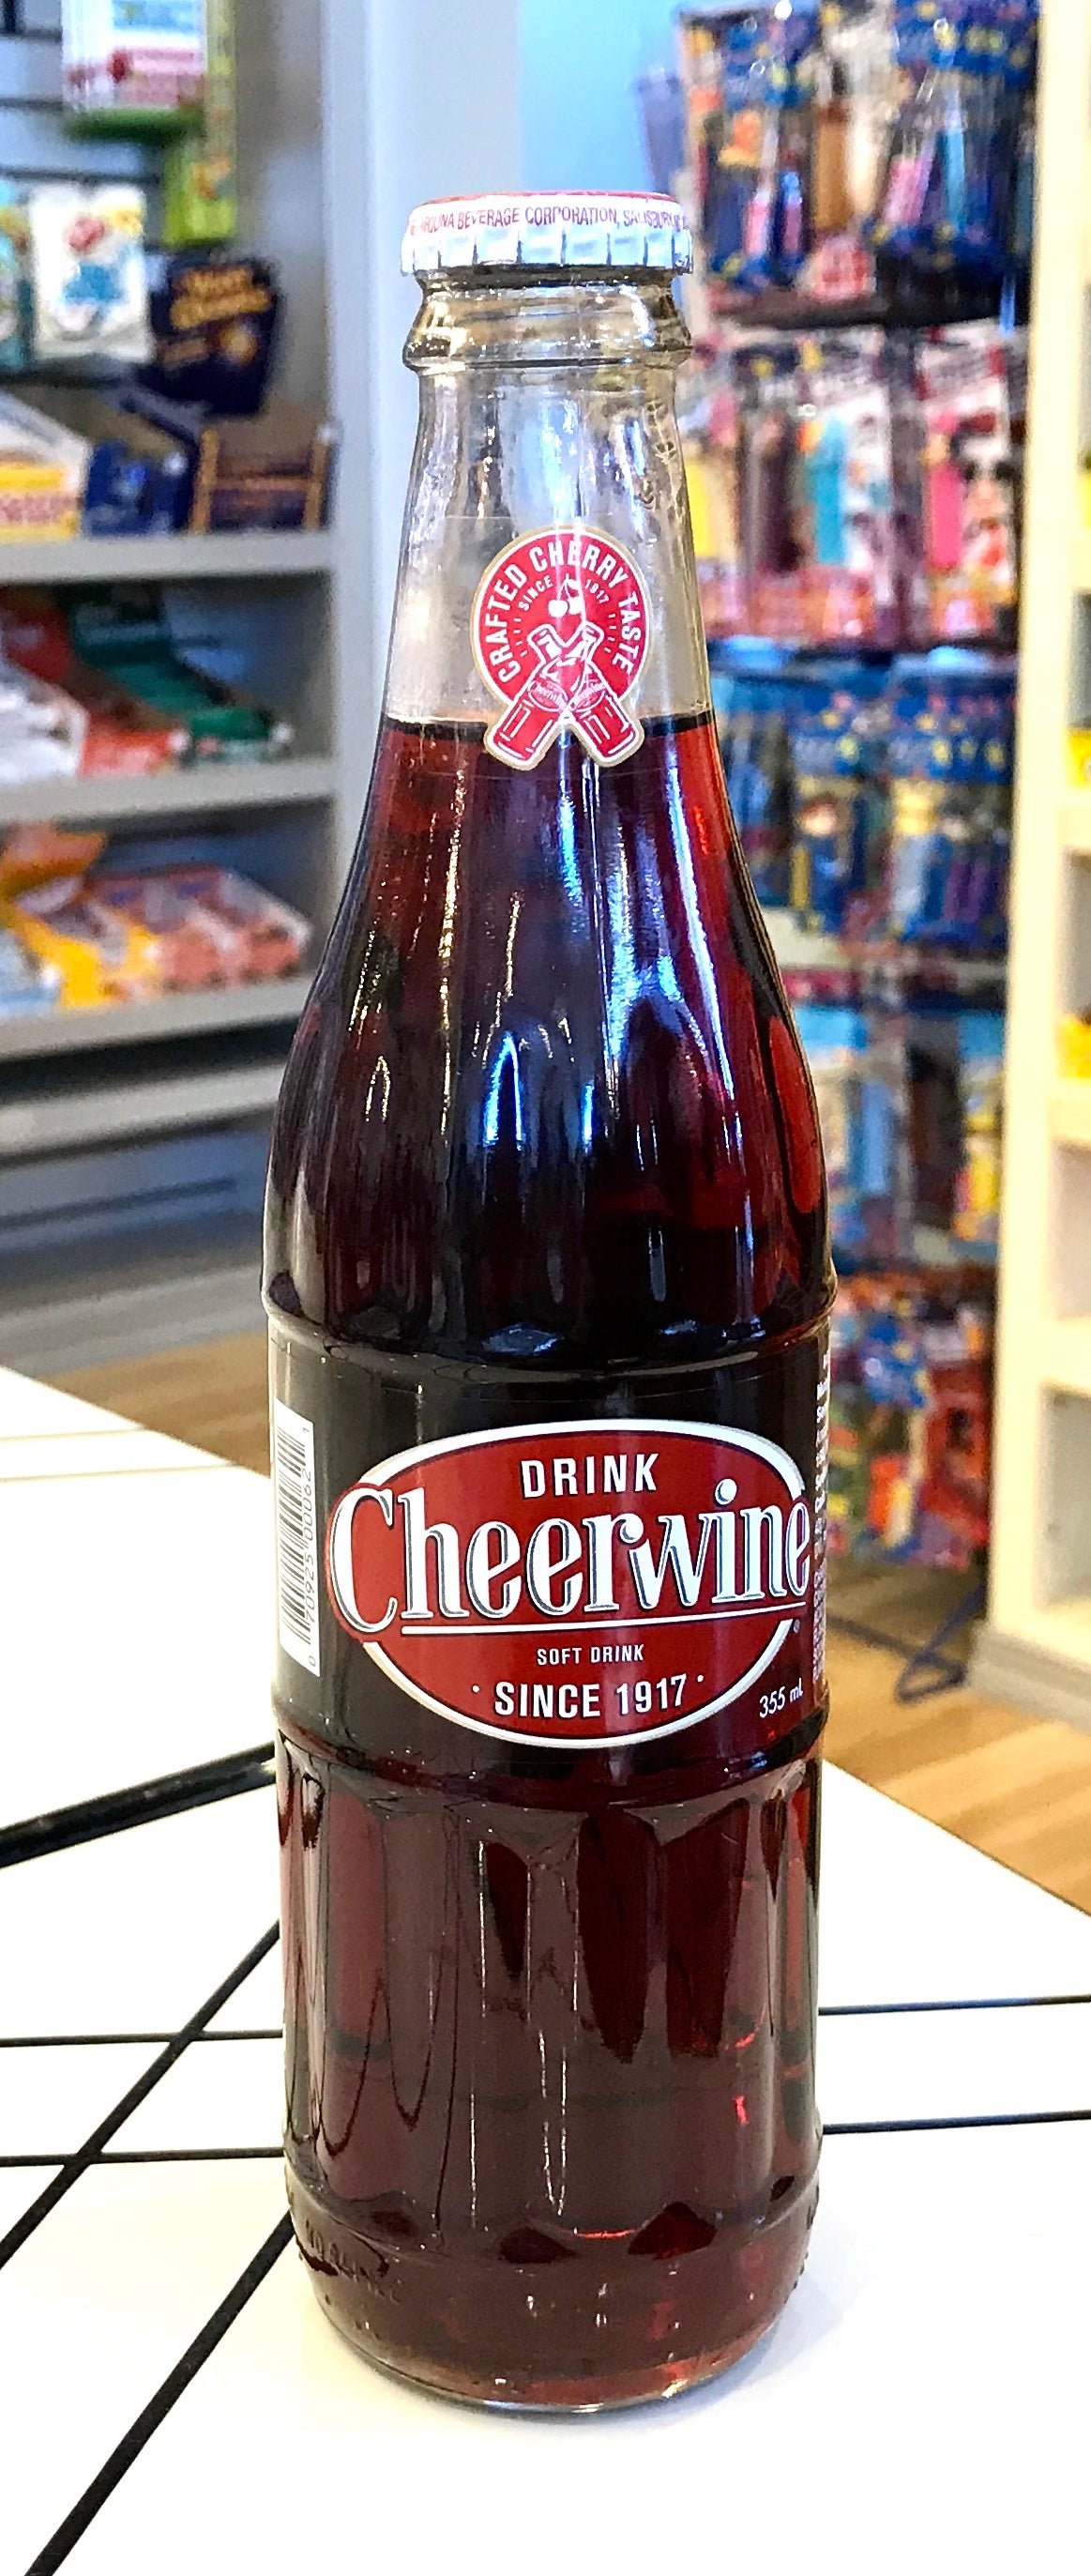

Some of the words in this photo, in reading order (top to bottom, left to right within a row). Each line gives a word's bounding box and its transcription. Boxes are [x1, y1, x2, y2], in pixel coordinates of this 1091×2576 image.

[457, 207, 520, 231] BEVERAGE
[484, 563, 528, 683] CRAFTED
[528, 540, 629, 588] CHERRY
[612, 590, 642, 675] TASTE
[518, 574, 554, 612] SINCE
[583, 578, 610, 604] 1917
[521, 1453, 659, 1499] DRINK
[328, 1479, 811, 1634] Cheerwine
[537, 1647, 583, 1666] SOFT
[590, 1644, 644, 1664] DRINK
[493, 1681, 601, 1719] SINCE
[616, 1672, 688, 1715] 1917
[759, 1685, 786, 1718] 355
